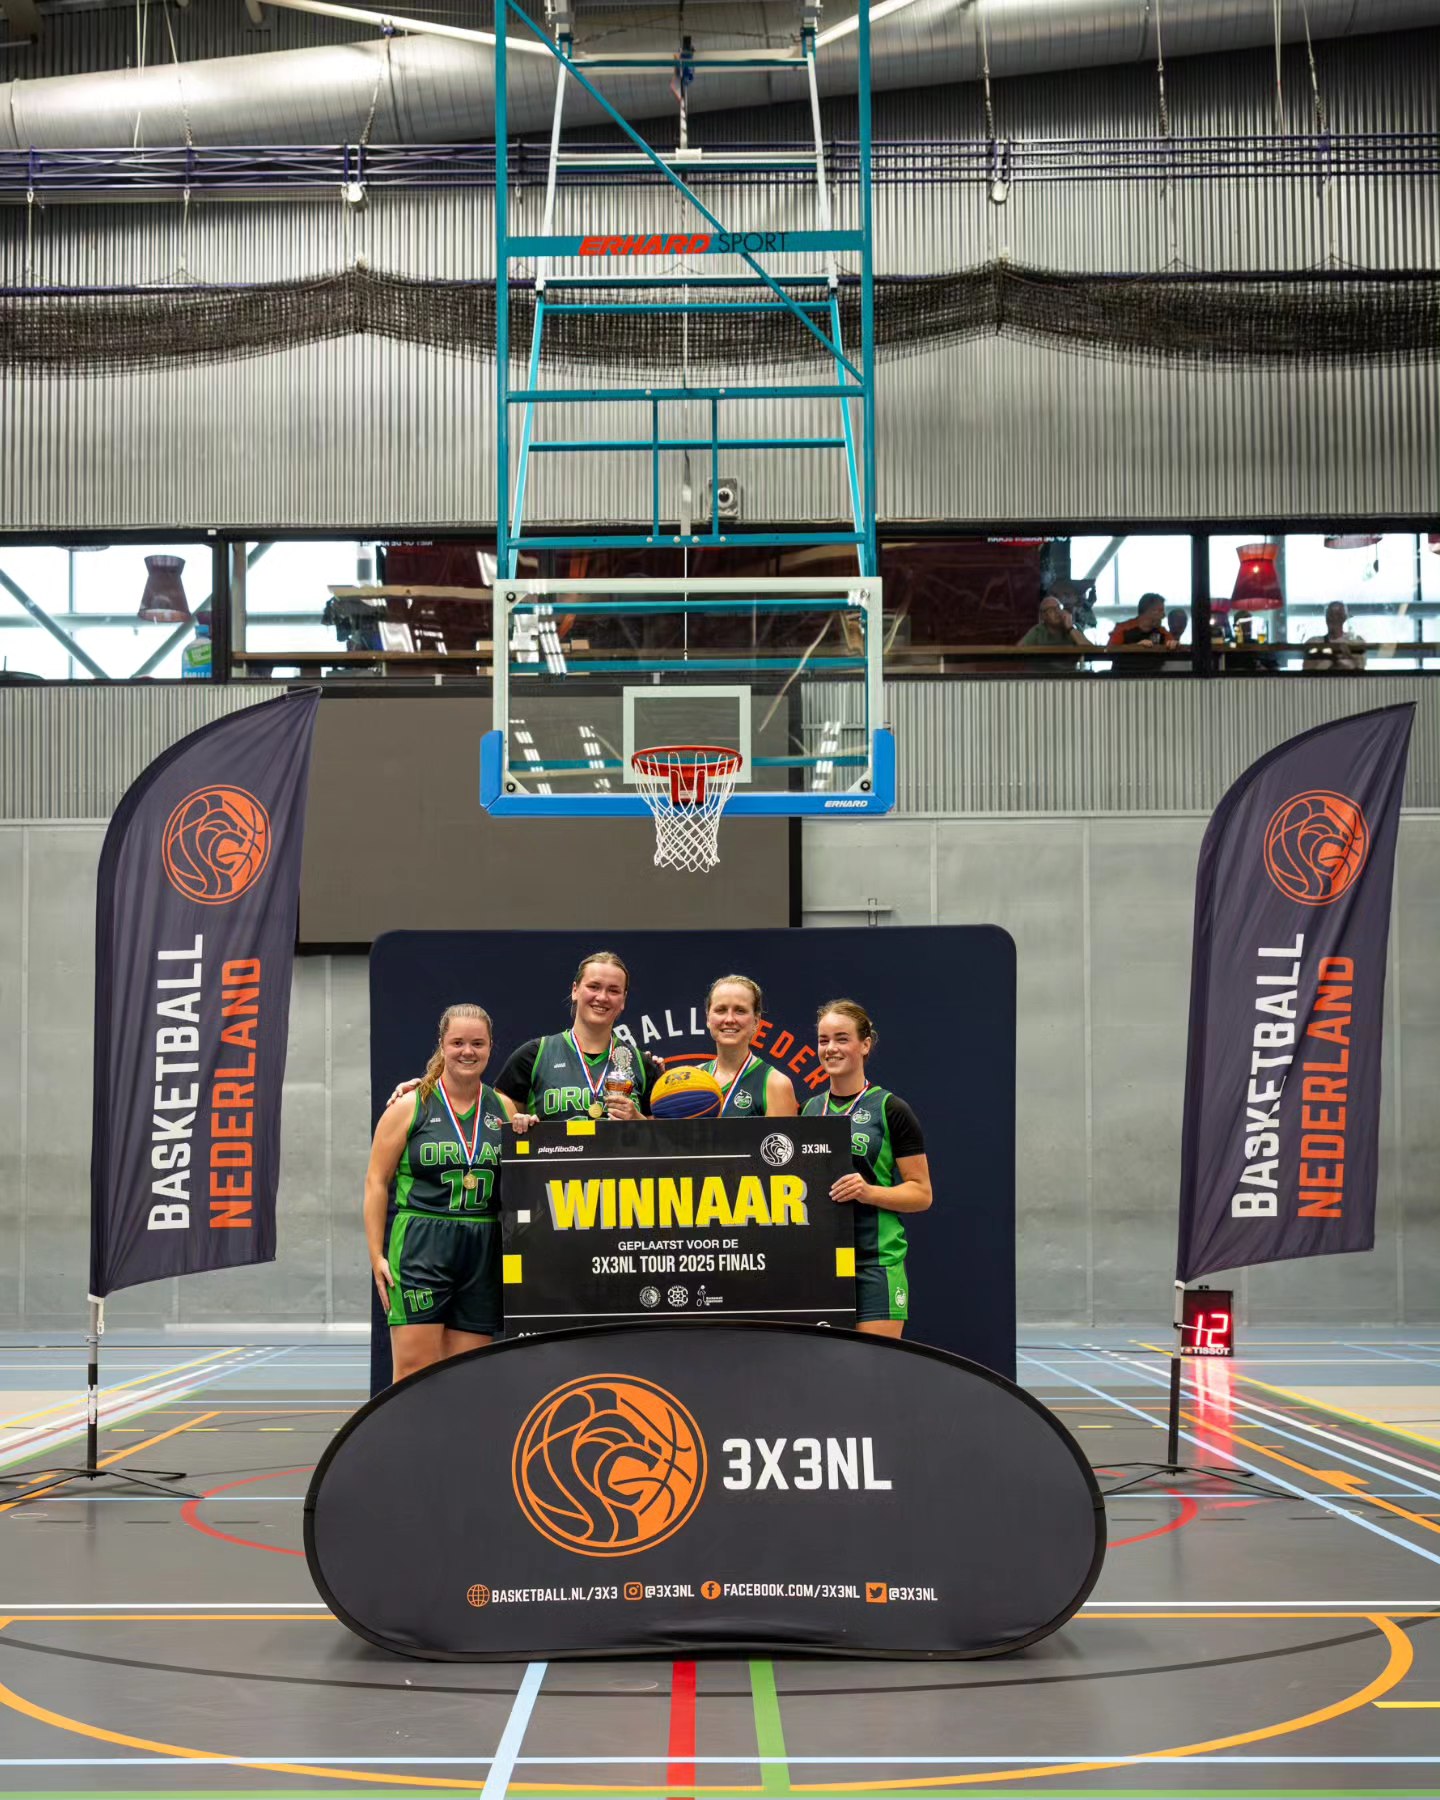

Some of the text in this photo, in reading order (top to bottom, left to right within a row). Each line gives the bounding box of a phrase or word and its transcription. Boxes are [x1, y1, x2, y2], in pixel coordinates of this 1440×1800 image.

[579, 232, 789, 256] ERHARD SPORT
[824, 800, 869, 808] ERHARD
[612, 1007, 705, 1048] BALL
[147, 934, 203, 1230] BASKETBALL
[209, 957, 260, 1228] NEDERLAND
[1231, 933, 1304, 1217] BASKETBALL
[1297, 956, 1354, 1218] NEDERLAND
[801, 1143, 832, 1154] 3X3NL
[441, 1169, 495, 1211] 10
[546, 1175, 810, 1230] WINNAAR
[618, 1239, 739, 1251] GEPLAATST VOOR DE
[592, 1252, 766, 1274] 3X3NL TOUR 2025 FINALS
[403, 1287, 434, 1312] 10
[1196, 1313, 1229, 1348] 12
[1194, 1347, 1230, 1355] TISSOT
[722, 1437, 893, 1491] 3X3NL
[491, 1582, 938, 1604] BASKETBALL.NL/3X3 @3X3NL FACEBOOK.COM/3X3NL @3X3NL
